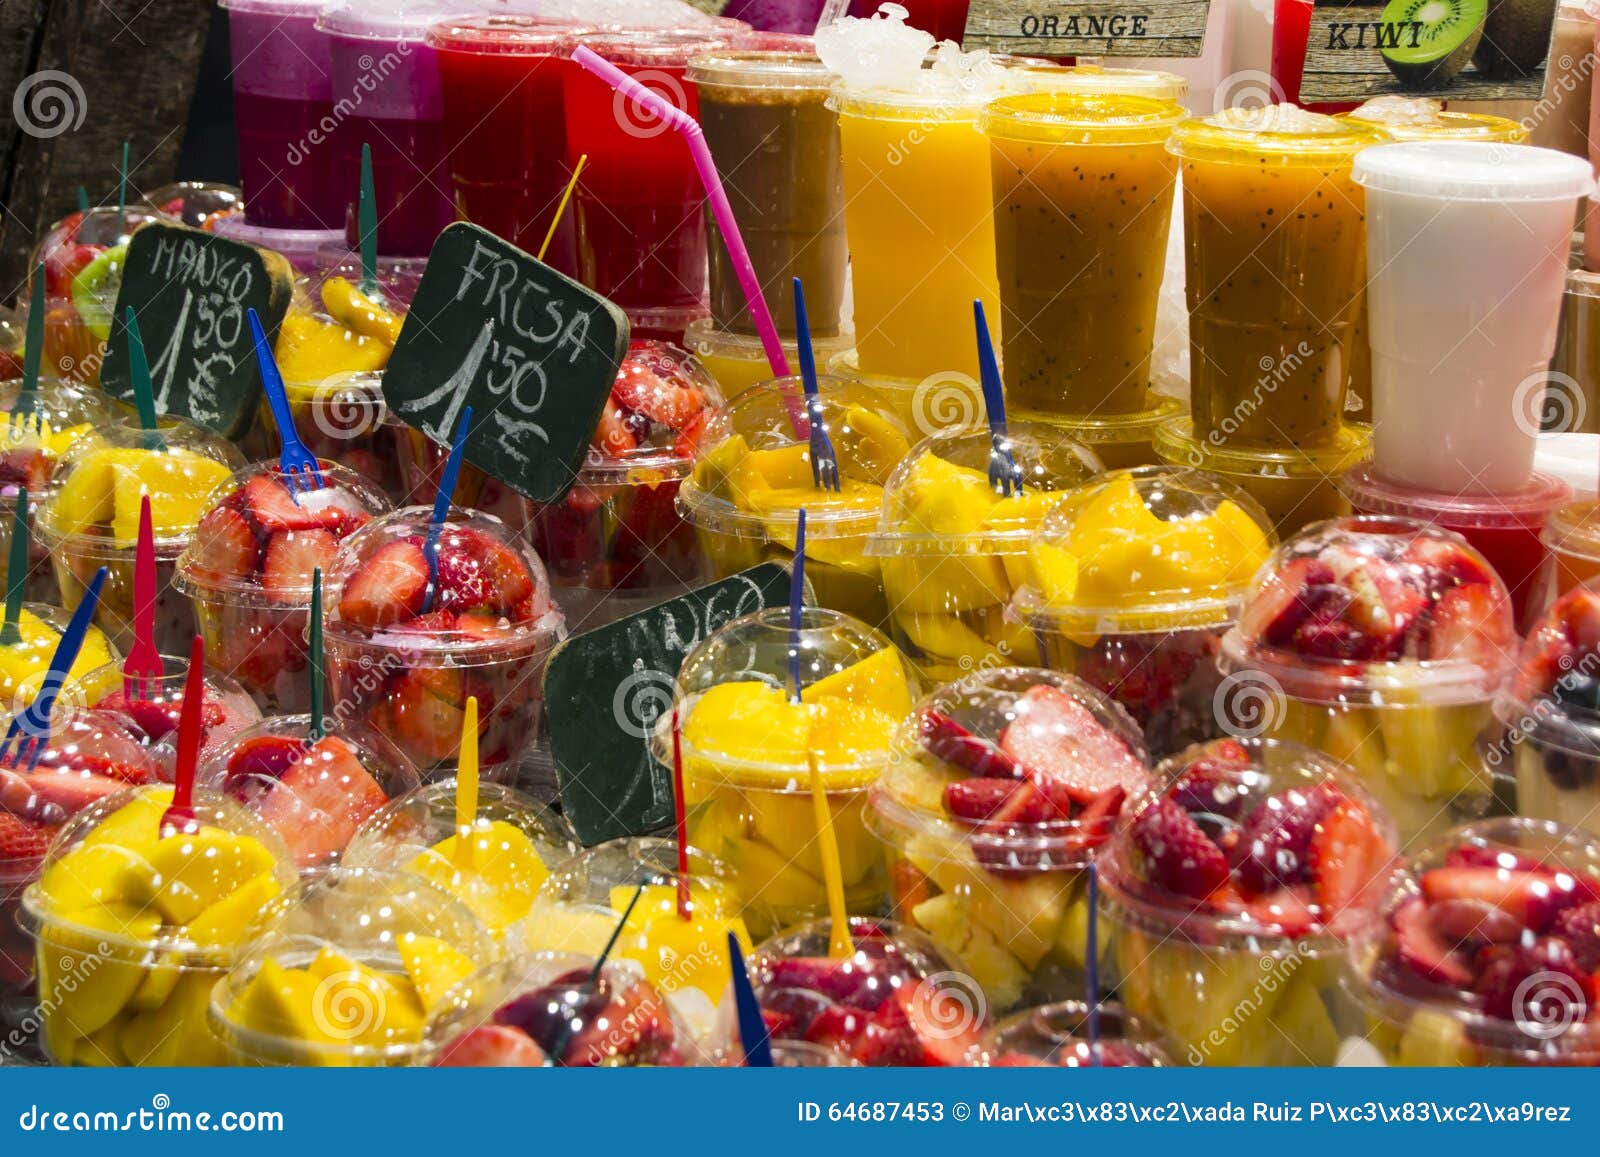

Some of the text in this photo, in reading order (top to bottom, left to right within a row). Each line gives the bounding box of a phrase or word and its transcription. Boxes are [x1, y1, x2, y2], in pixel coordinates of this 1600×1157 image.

[1020, 15, 1149, 37] ORANGE
[1324, 21, 1425, 50] KIWI
[151, 237, 252, 300] MANGO
